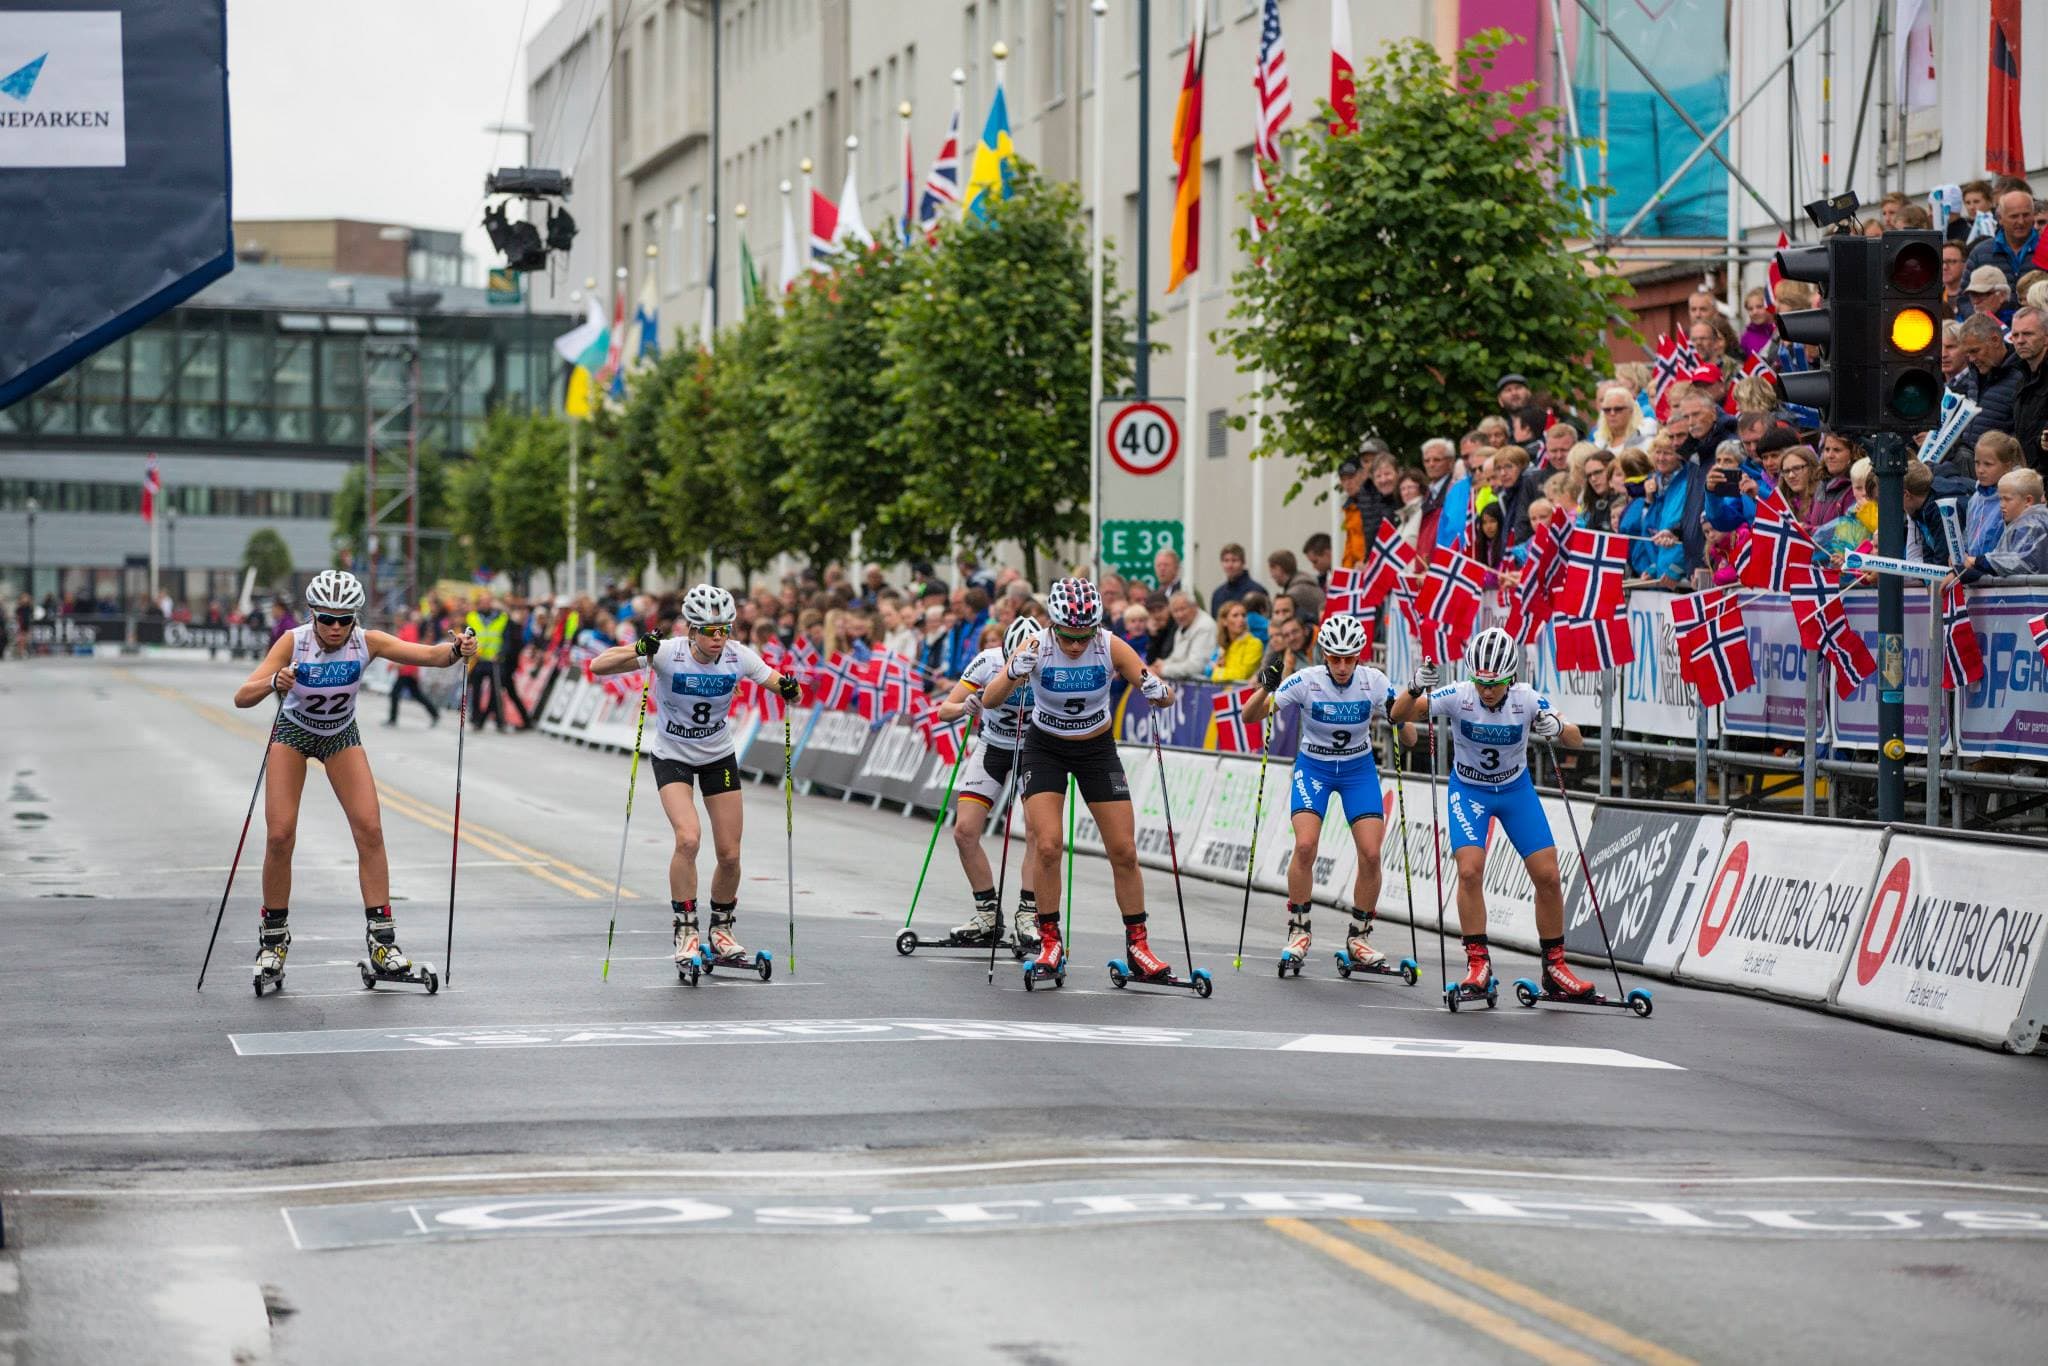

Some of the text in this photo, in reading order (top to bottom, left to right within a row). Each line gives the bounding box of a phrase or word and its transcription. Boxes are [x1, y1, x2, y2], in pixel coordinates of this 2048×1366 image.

[1121, 422, 1165, 455] 40
[1112, 530, 1174, 555] E 39
[1628, 610, 1660, 704] DN
[325, 663, 348, 676] VVS
[1068, 669, 1094, 681] VVS
[308, 676, 348, 686] EKSPERTEN
[700, 676, 724, 687] VVS
[1052, 681, 1095, 690] EKSPERTEN
[305, 692, 351, 715] 22
[691, 701, 713, 725] 8
[1063, 697, 1086, 716] 5
[1338, 703, 1360, 715] VVS
[1040, 709, 1105, 729] Multiconsult
[2016, 719, 2031, 731] Your
[1331, 729, 1352, 749] 9
[1486, 727, 1511, 737] VVS
[1480, 748, 1500, 771] 3
[1452, 801, 1478, 841] sportful
[1729, 873, 1863, 954] MULTIBLOKK
[1891, 895, 2044, 989] MULTIBLOKK
[1907, 981, 1920, 1004] Ha
[1920, 984, 1933, 1007] det
